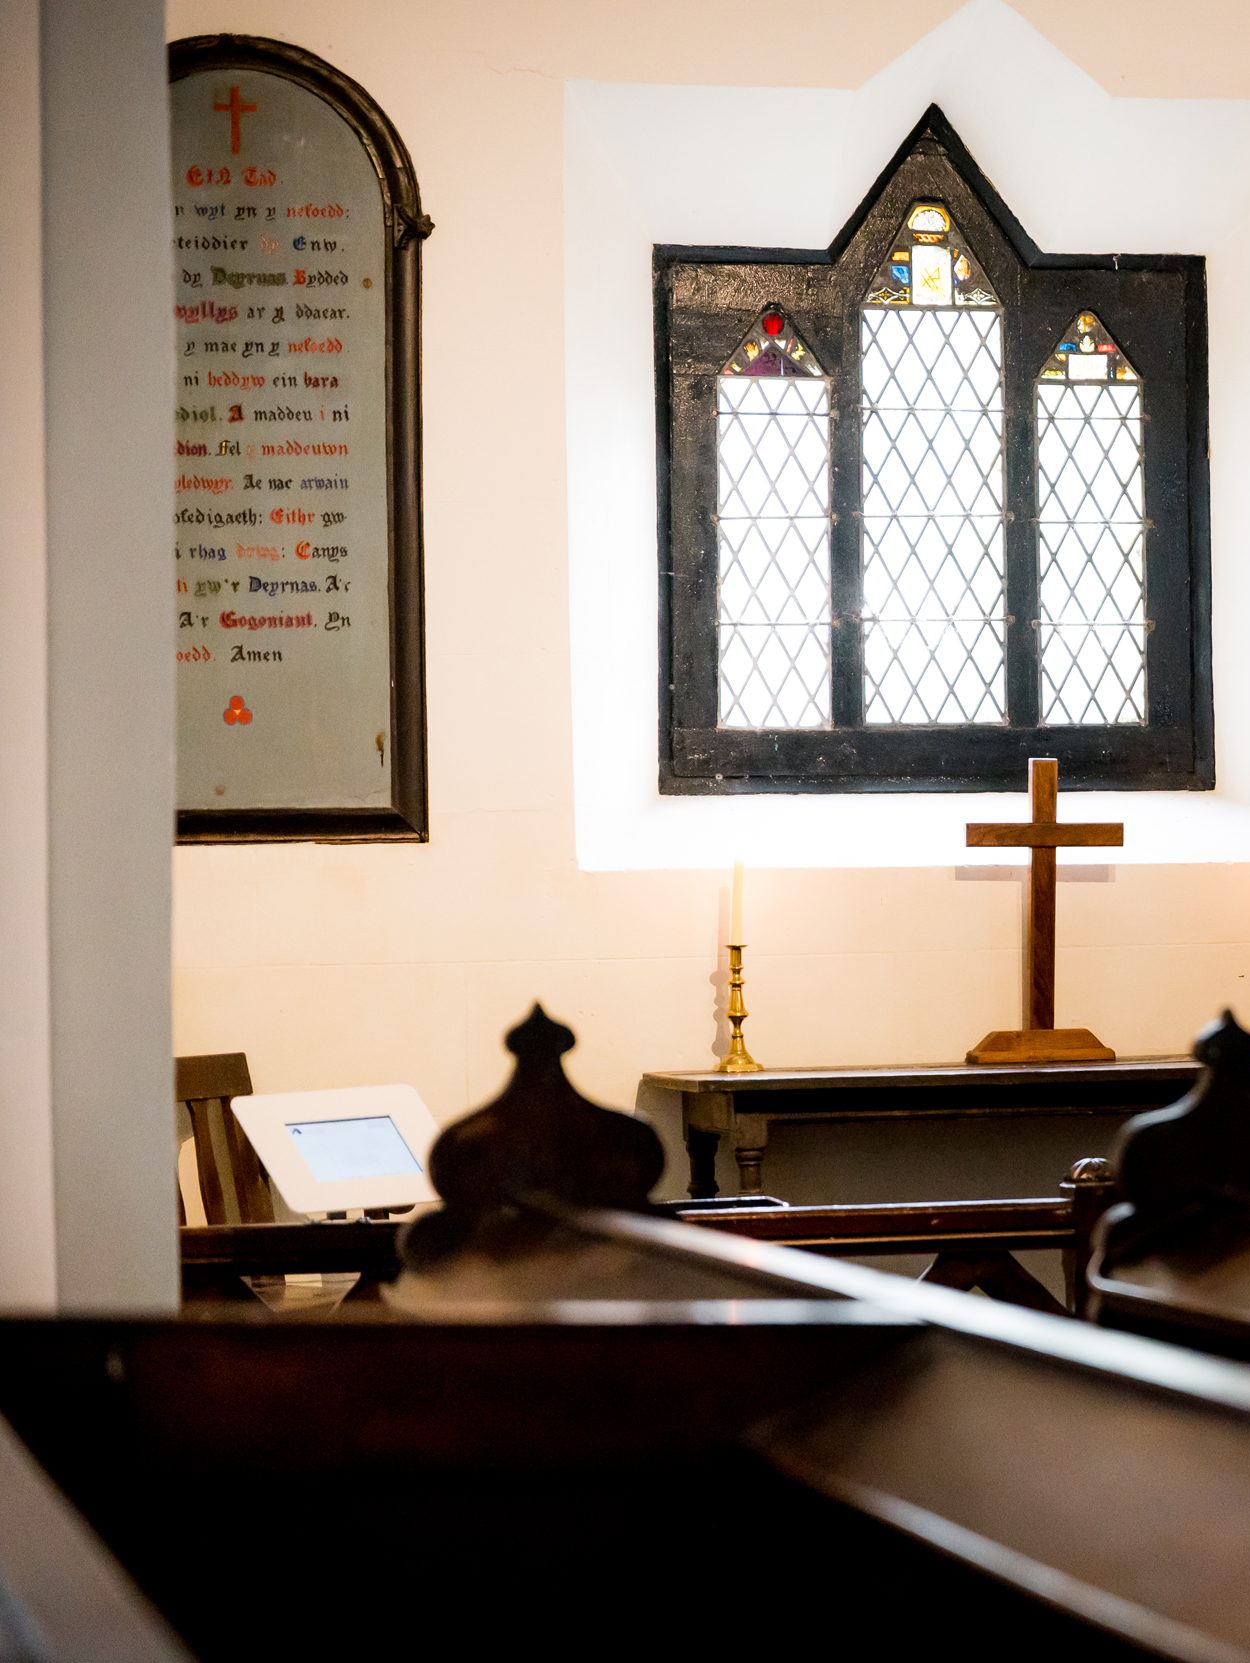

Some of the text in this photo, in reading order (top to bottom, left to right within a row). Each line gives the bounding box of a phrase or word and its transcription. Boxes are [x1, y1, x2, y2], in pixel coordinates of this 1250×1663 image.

[194, 203, 226, 220] wyt
[234, 205, 257, 221] yn
[265, 205, 276, 221] y
[260, 234, 280, 255] dy
[182, 268, 203, 288] dy
[292, 269, 349, 288] Bydded
[246, 306, 266, 320] ar
[272, 305, 286, 324] y
[183, 341, 195, 356] y
[204, 341, 237, 353] mae
[242, 341, 264, 358] yn
[268, 342, 280, 357] y
[183, 371, 339, 391] ni heddyw ein bara
[228, 402, 245, 424] A
[253, 405, 313, 422] maddeu
[320, 404, 325, 421] i
[332, 404, 350, 422] ni
[215, 440, 241, 456] Fel
[261, 439, 349, 456] maddeuwn
[268, 477, 293, 491] nac
[300, 472, 349, 490] arwain
[269, 507, 316, 527] Eithr
[189, 544, 227, 561] rhag
[295, 540, 348, 563] Canys
[249, 576, 321, 596] Deyrnas.
[179, 611, 209, 629] A'r
[324, 611, 352, 631] Yn
[230, 643, 283, 663] Amen
